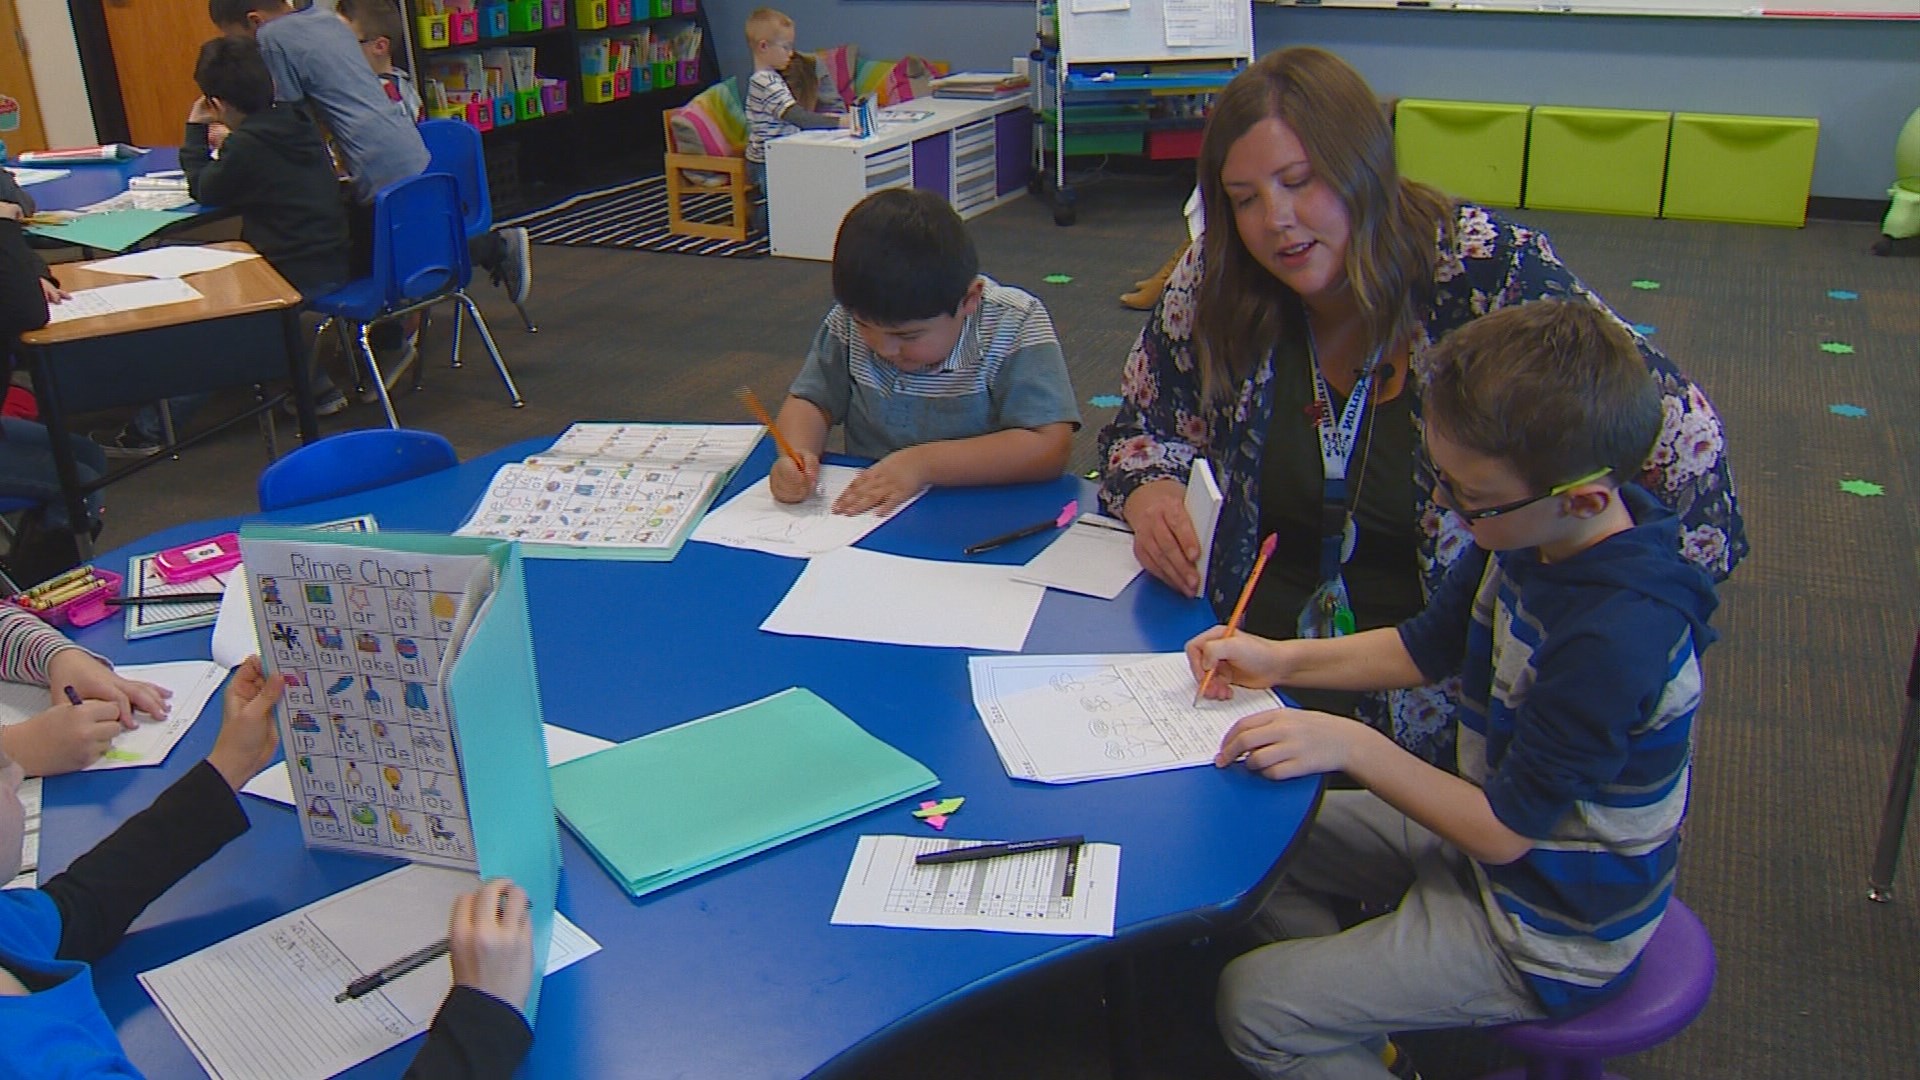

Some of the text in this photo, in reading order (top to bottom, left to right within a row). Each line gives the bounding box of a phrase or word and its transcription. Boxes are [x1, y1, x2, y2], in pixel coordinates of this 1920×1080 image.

[290, 553, 433, 588] Rime Chart
[267, 603, 294, 617] an
[309, 607, 337, 621] ap
[352, 611, 376, 624] ar
[393, 608, 419, 631] at
[319, 651, 352, 667] ain
[361, 655, 396, 672] ake
[402, 657, 429, 677] all
[330, 697, 355, 711] en
[337, 736, 368, 755] ick
[377, 740, 411, 760] ide
[305, 775, 337, 793] ine
[345, 783, 378, 804] ing
[352, 825, 379, 841] ug
